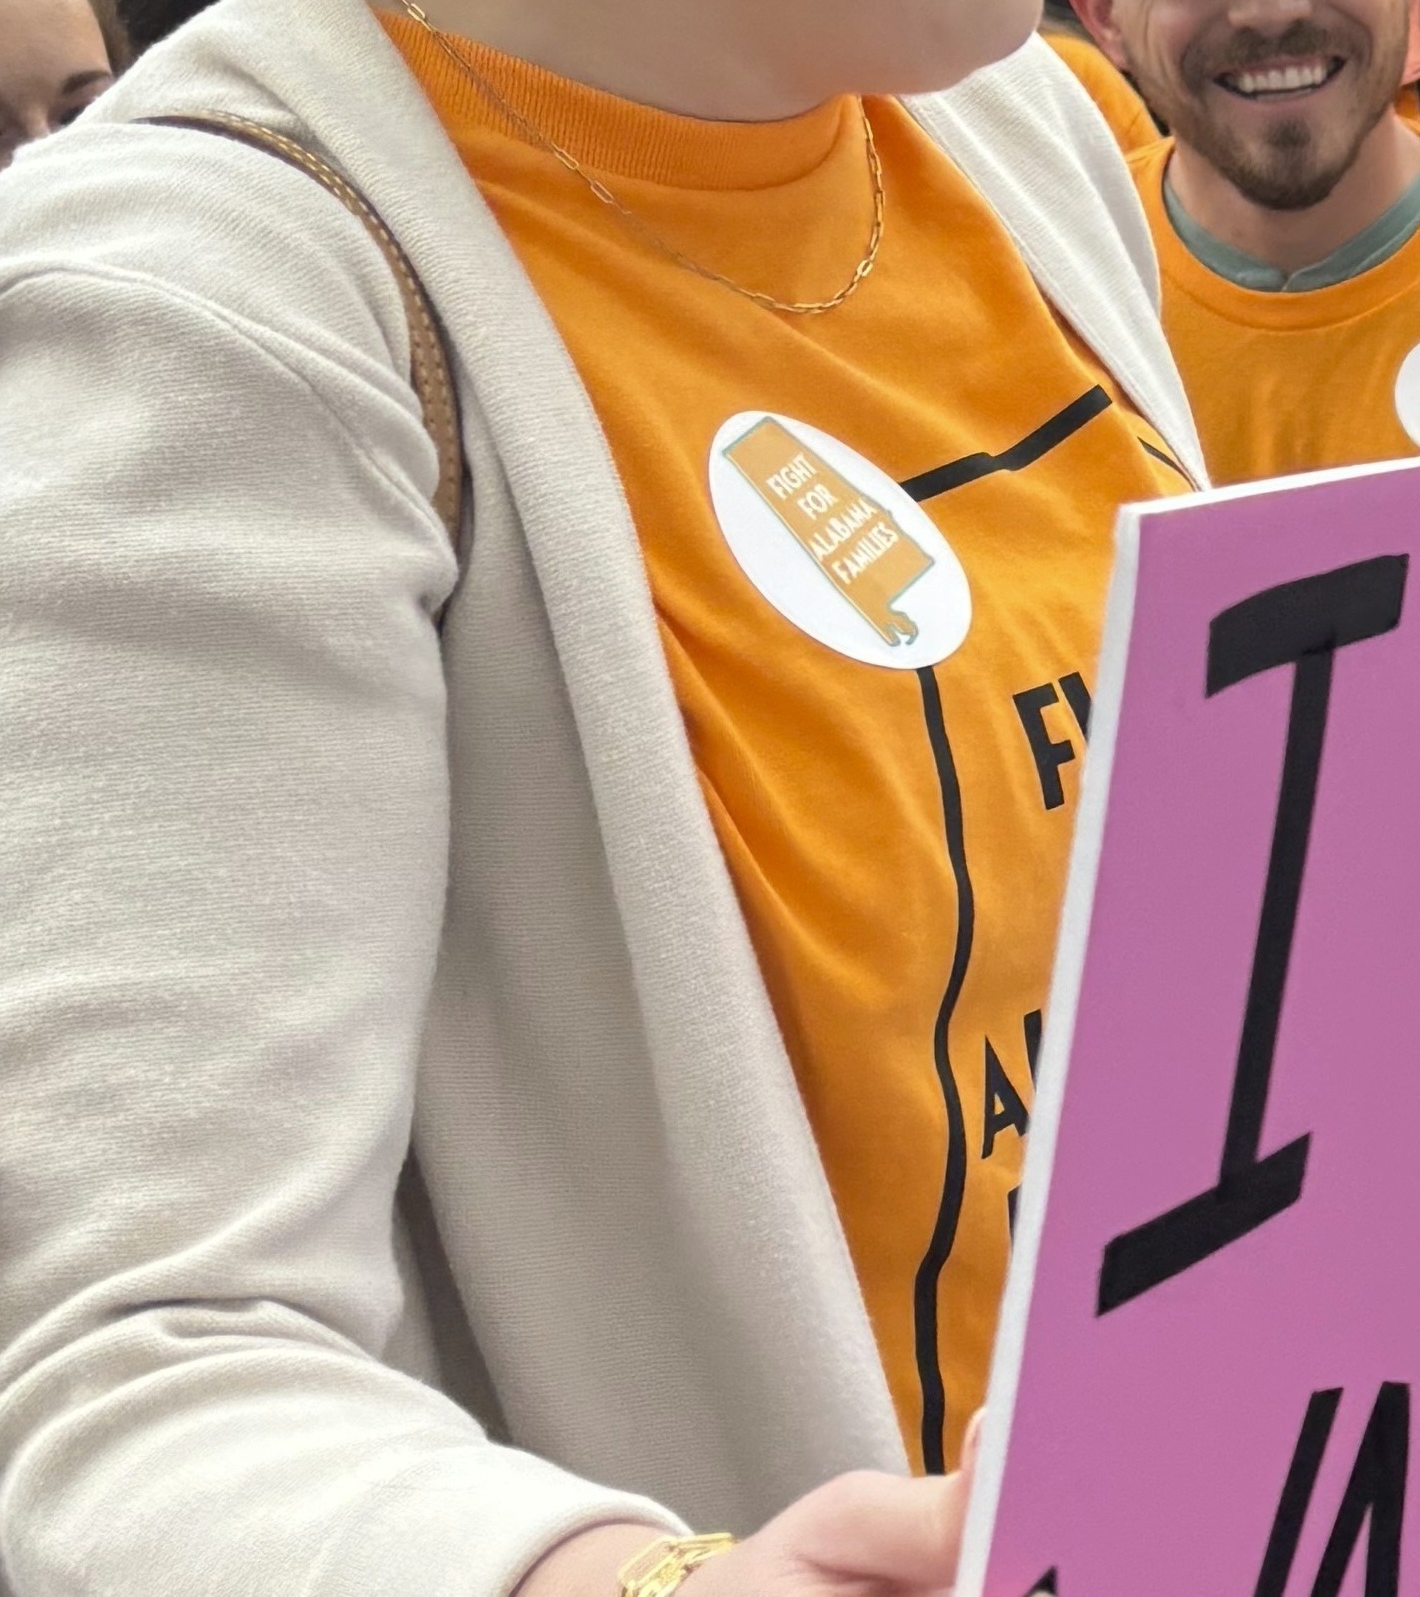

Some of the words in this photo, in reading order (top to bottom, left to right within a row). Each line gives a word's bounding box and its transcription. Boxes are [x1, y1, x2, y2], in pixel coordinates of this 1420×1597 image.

[766, 452, 819, 501] FIGHT
[797, 483, 839, 521] FOR
[808, 495, 878, 562] ALABAMA
[831, 520, 900, 585] FAMILIES
[1097, 553, 1409, 1316] I
